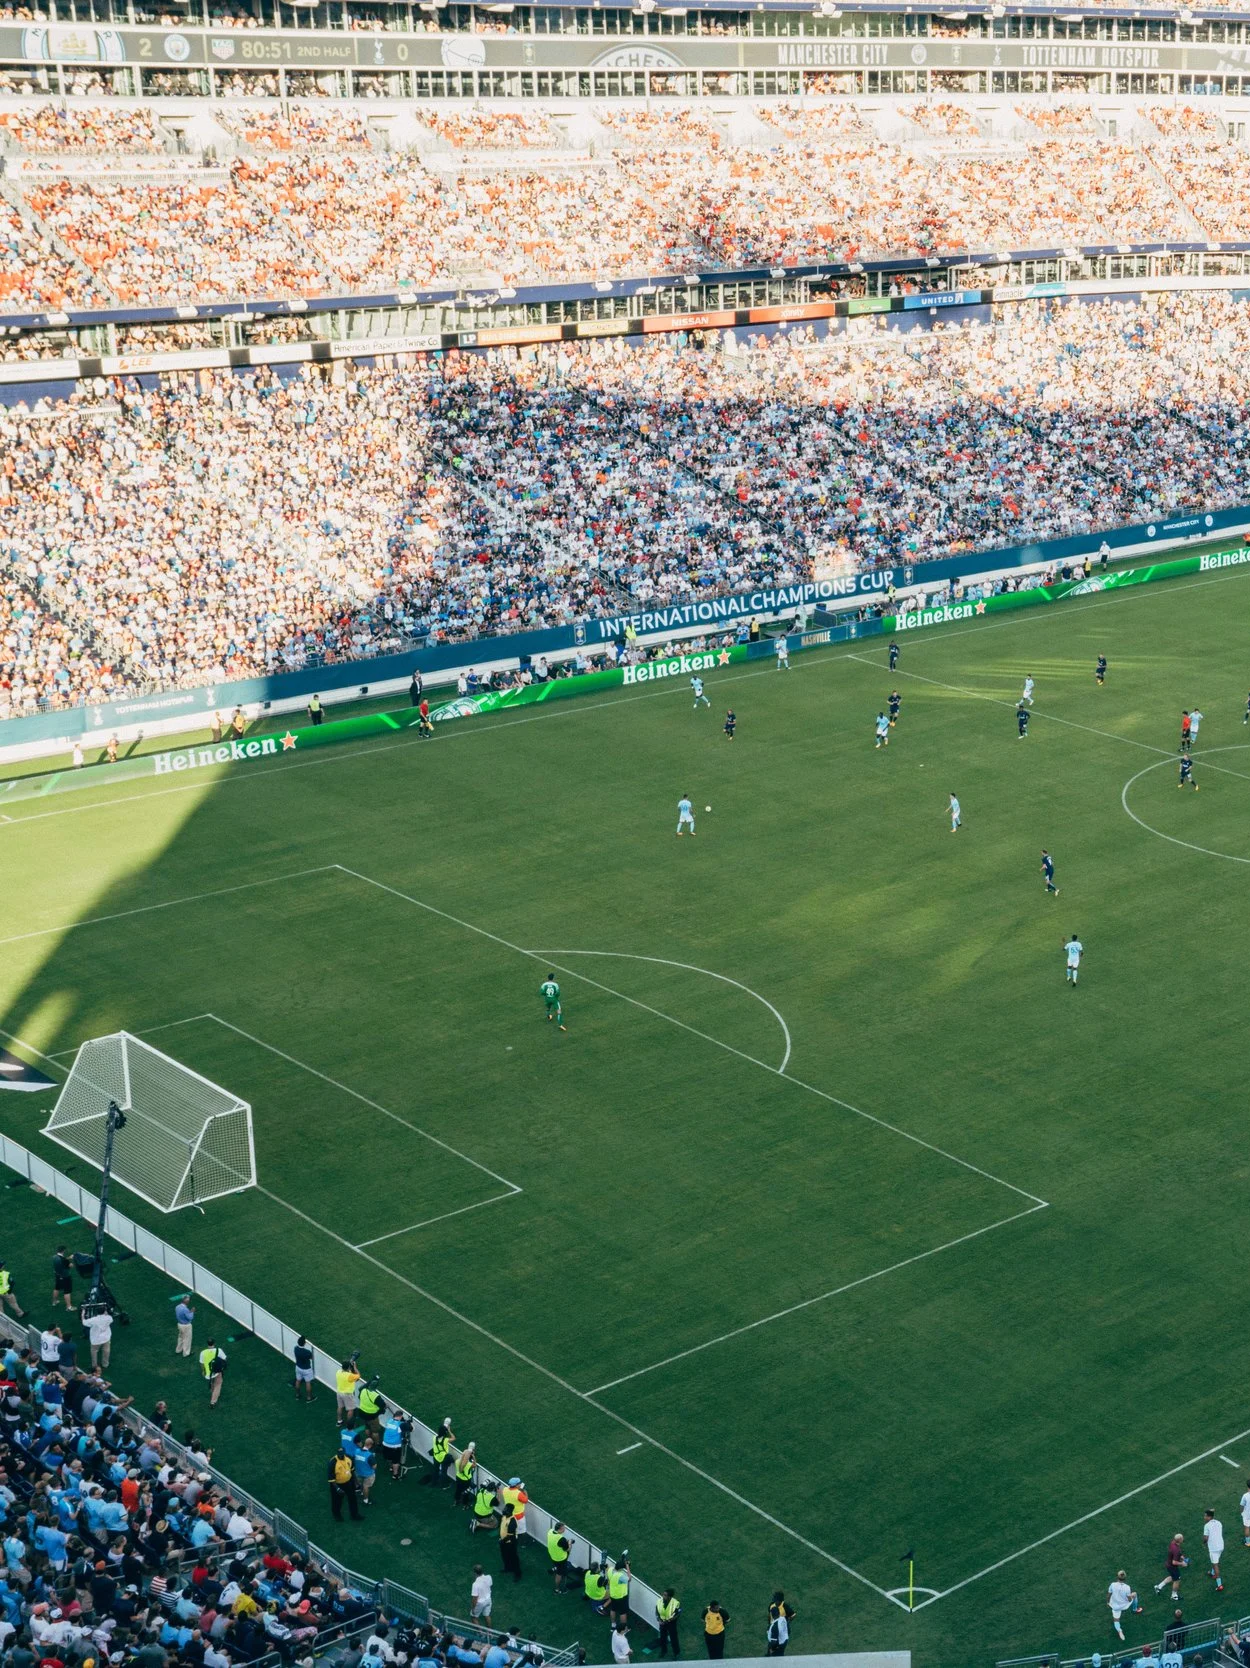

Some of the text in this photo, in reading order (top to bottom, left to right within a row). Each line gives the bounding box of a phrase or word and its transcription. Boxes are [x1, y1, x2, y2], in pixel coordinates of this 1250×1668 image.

[138, 37, 153, 56] 2
[241, 41, 351, 59] 80:51 2ND HALF
[397, 43, 408, 61] 0
[778, 44, 889, 65] MANCHESTER CITY
[1022, 46, 1159, 67] TOTTENHAM HOTSPUR
[921, 296, 954, 305] UNITED
[671, 317, 709, 327] NISSAN
[334, 343, 371, 353] American
[404, 338, 427, 348] Twine
[462, 334, 476, 344] LP
[131, 357, 151, 367] LEE
[1163, 521, 1190, 530] MANCHESTER
[600, 570, 894, 638] INTERNATIONAL CHAMPIONS CUP
[895, 603, 974, 632] Heineken
[801, 630, 831, 646] NASHVILLE
[623, 652, 715, 685] Heineken
[115, 695, 194, 715] TOTTENHAM HOTSPUR
[153, 733, 278, 775] Heineken
